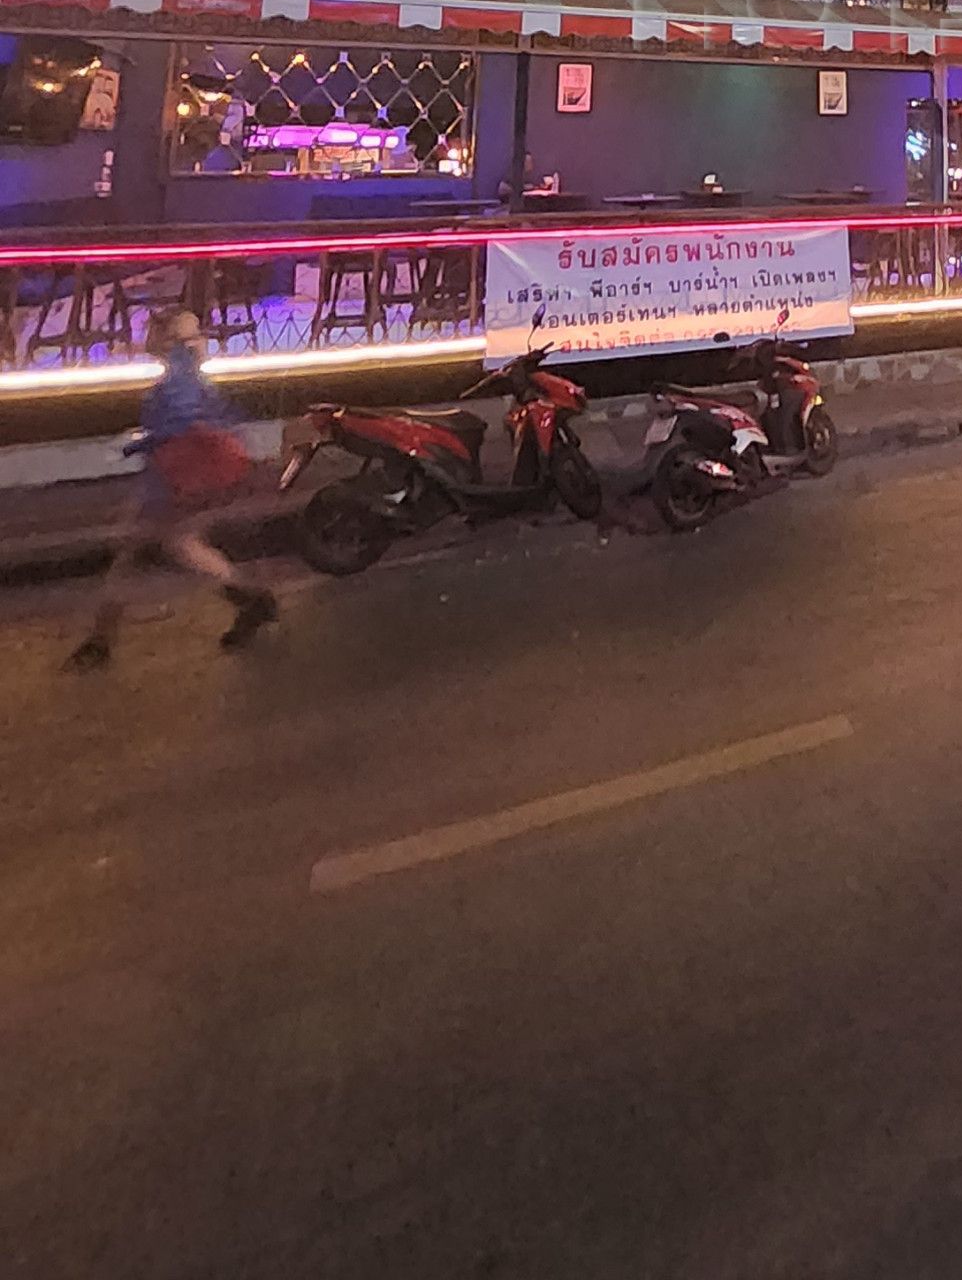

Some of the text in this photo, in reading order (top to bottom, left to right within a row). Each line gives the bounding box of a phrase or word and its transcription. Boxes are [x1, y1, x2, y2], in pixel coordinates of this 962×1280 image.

[558, 233, 796, 270] รับสมัครพนักงาน
